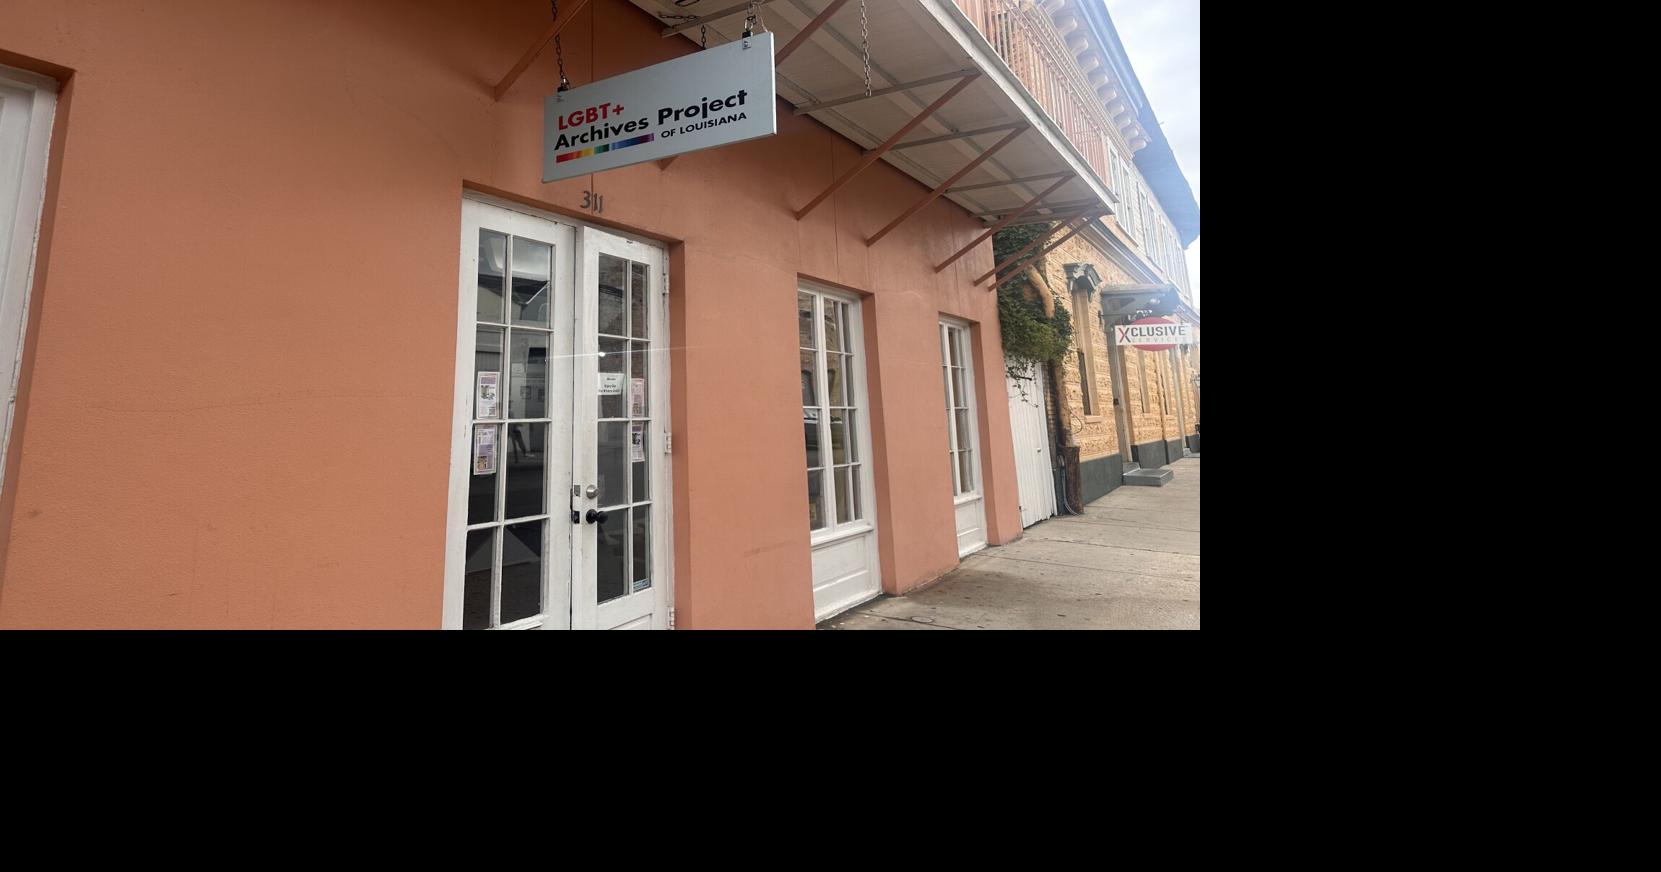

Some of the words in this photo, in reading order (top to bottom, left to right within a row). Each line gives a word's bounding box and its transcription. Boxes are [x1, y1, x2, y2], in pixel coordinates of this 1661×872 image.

[554, 117, 649, 150] Archives
[657, 89, 748, 125] Project
[558, 102, 625, 130] LGBT+
[660, 128, 677, 139] OF
[679, 112, 747, 135] LOUISIANA
[579, 190, 604, 214] 311
[1118, 325, 1187, 343] XCLUSIVE
